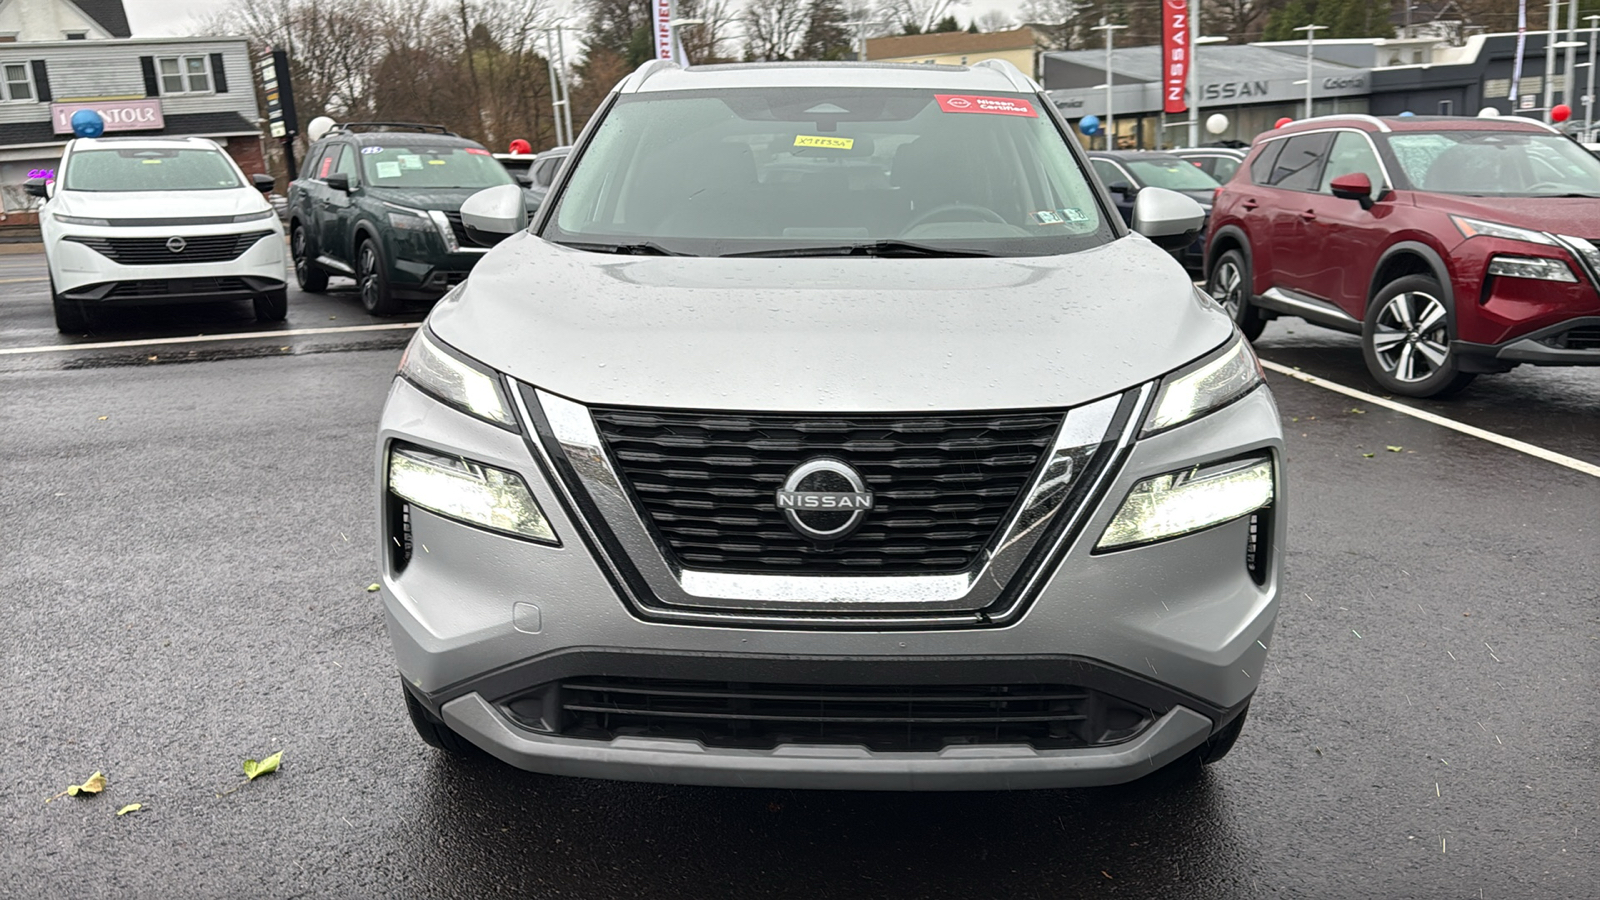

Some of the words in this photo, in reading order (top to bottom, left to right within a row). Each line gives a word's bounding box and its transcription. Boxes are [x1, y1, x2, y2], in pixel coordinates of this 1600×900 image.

[1168, 14, 1185, 100] NISSAN
[976, 98, 1015, 107] Nissan
[979, 103, 1028, 113] Certified
[779, 494, 871, 508] NISSAN
